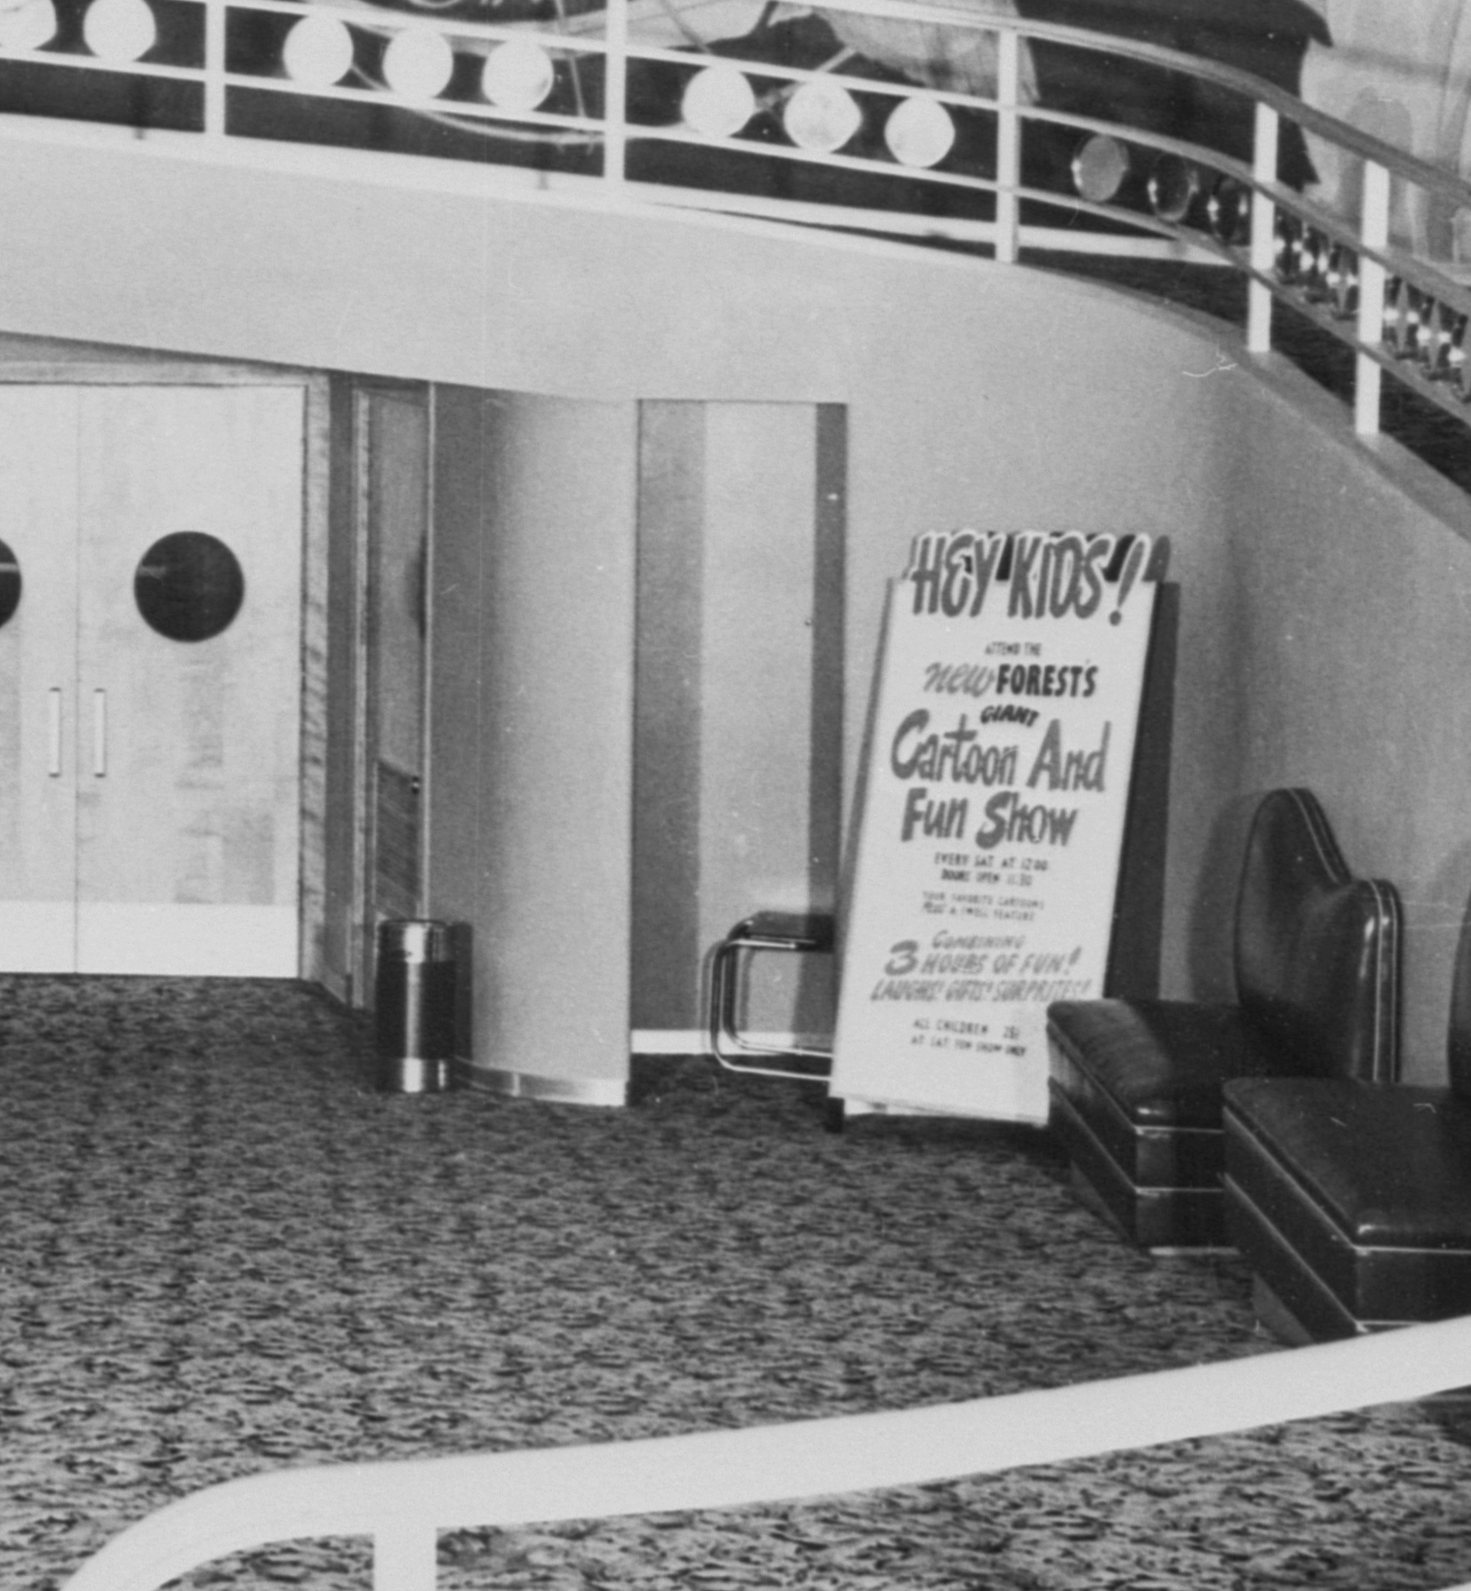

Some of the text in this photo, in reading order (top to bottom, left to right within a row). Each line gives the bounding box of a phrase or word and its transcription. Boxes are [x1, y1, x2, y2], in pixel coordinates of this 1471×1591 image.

[910, 531, 1148, 627] HEY KIDS!
[1024, 641, 1041, 656] THE
[923, 662, 995, 697] new
[980, 704, 1040, 727] GIANT
[891, 708, 1111, 792] Cartoon And
[901, 787, 1078, 850] Fun Show
[934, 851, 970, 867] EVERY
[1001, 856, 1016, 868] AT
[976, 871, 999, 884] OPEN
[885, 939, 919, 976] 3
[920, 953, 987, 975] HOURS
[993, 953, 1019, 975] OF
[936, 1019, 989, 1036] CHILDREN
